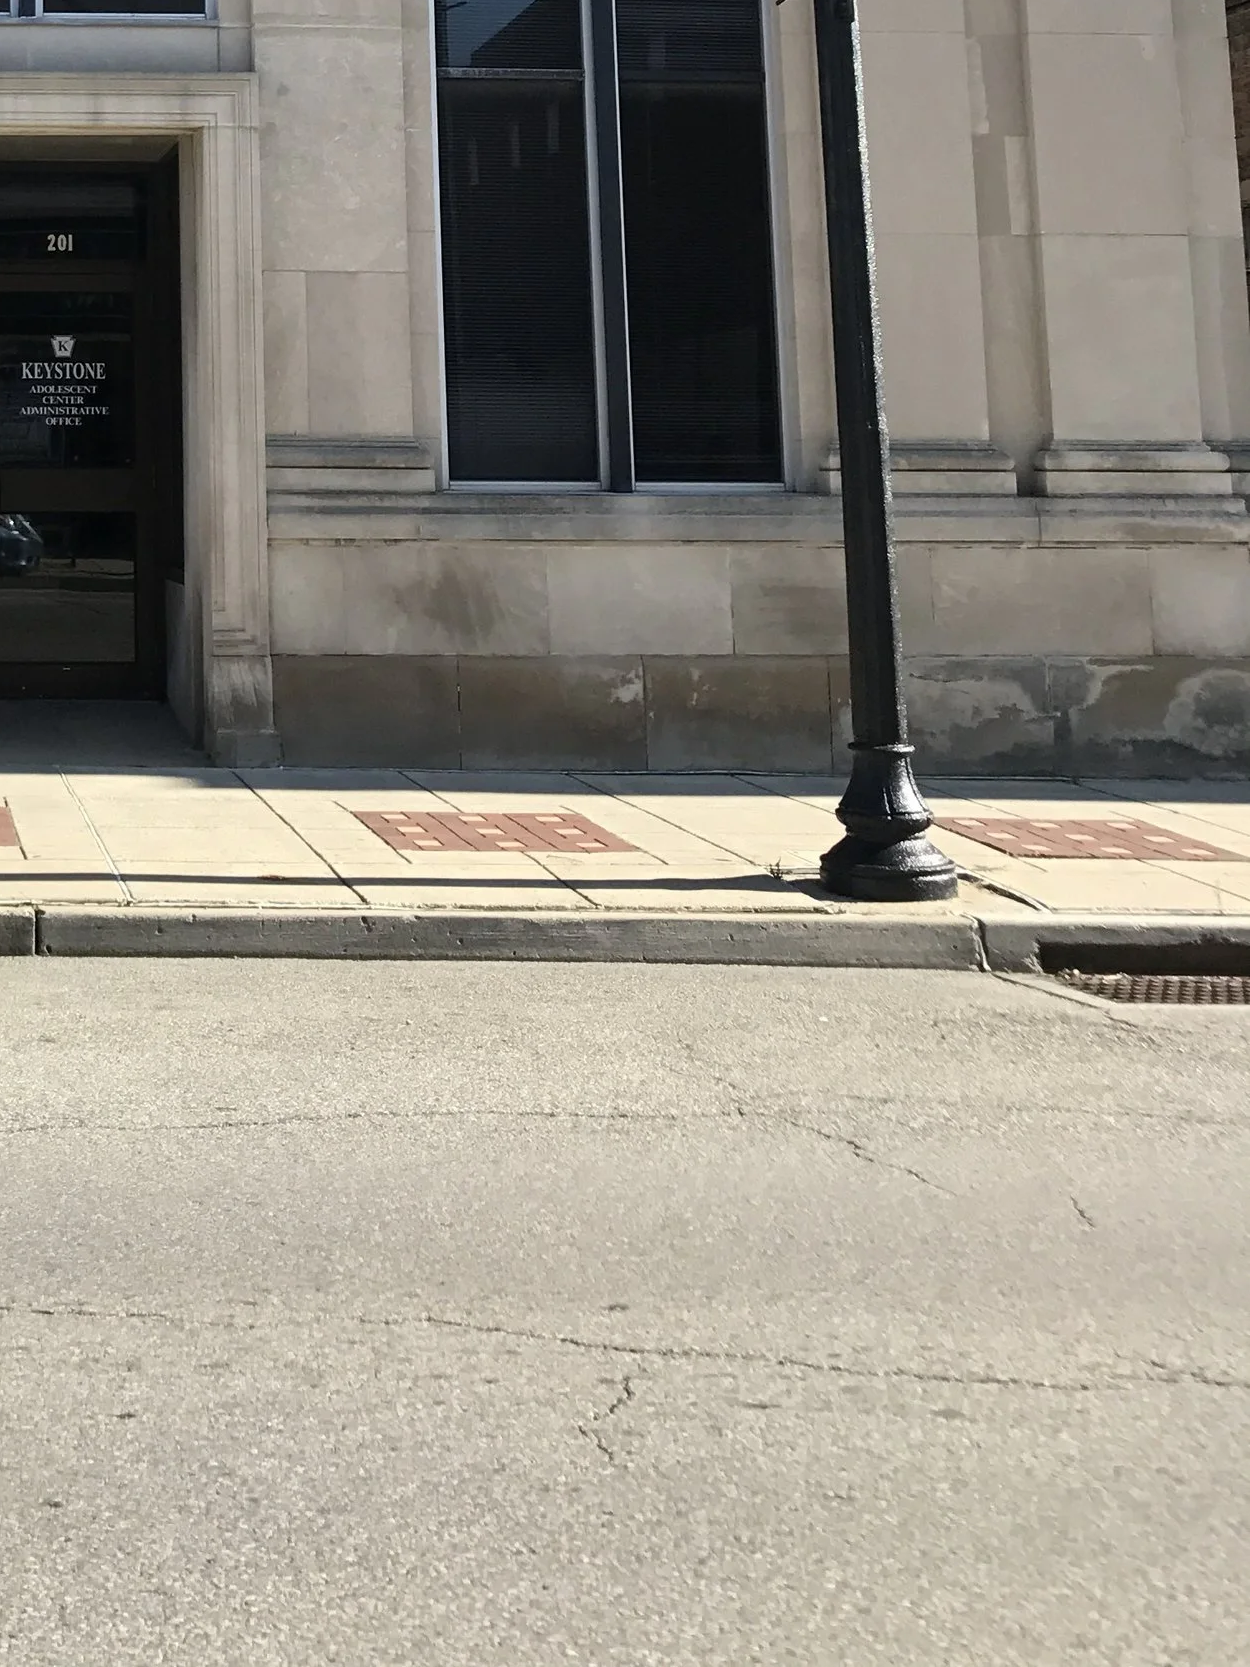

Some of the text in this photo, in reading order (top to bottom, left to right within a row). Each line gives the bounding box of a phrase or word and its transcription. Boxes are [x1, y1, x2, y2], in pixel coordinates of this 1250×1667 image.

[47, 234, 73, 252] 201
[58, 340, 69, 351] K
[21, 362, 106, 380] KEYSTONE
[29, 385, 97, 394] ADOLESCENT
[42, 395, 84, 405] CENTER
[19, 406, 109, 415] ADMINISTRATIVE
[45, 417, 82, 426] OFFICE
